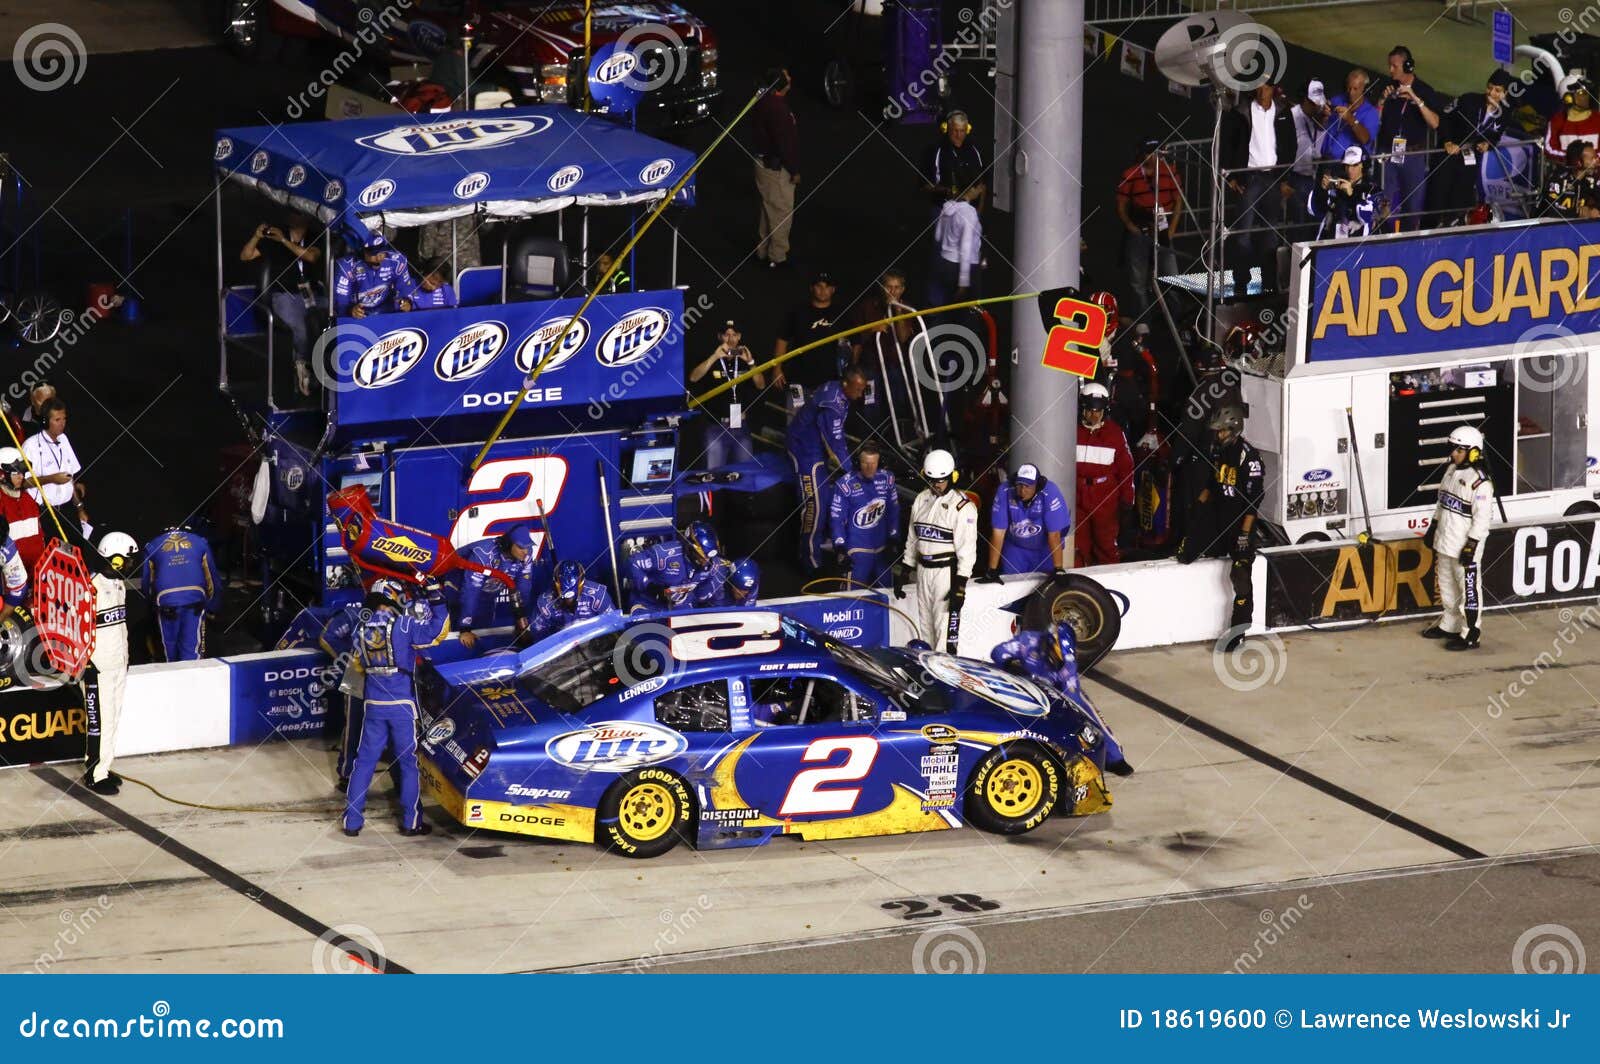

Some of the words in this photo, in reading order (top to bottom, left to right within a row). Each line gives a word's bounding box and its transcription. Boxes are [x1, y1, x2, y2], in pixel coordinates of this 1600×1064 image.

[1313, 264, 1409, 340] AIR
[456, 328, 488, 346] Miller
[616, 315, 648, 334] Miller
[1041, 296, 1108, 379] 2
[375, 335, 407, 353] Miller
[611, 320, 659, 363] Lite
[369, 340, 419, 386] Lite
[450, 333, 500, 381] Lite
[1309, 470, 1328, 481] Ford
[449, 454, 570, 561] 2
[372, 536, 431, 563] SUNOCO
[47, 569, 86, 610] STOP
[1320, 540, 1433, 618] AIR
[823, 610, 851, 623] Mobil
[760, 663, 785, 671] KURT
[787, 662, 818, 671] BUSCH
[618, 678, 660, 703] LENNOX
[9, 707, 87, 742] GUAR
[593, 728, 648, 741] Miller
[996, 729, 1050, 742] GOODYEAR
[474, 748, 489, 764] 2
[568, 738, 668, 763] Lite
[922, 756, 947, 765] Mobil
[777, 734, 880, 817] 2
[922, 765, 958, 775] MAHLE
[974, 759, 993, 796] EAGLE
[505, 783, 571, 801] Snap-on
[639, 769, 691, 821] GOODYEAR
[1025, 760, 1059, 829] GOODYEAR
[500, 813, 566, 827] DODGE
[701, 809, 760, 821] DISCOUNT
[608, 825, 637, 853] EAGLE
[880, 893, 1002, 920] 28
